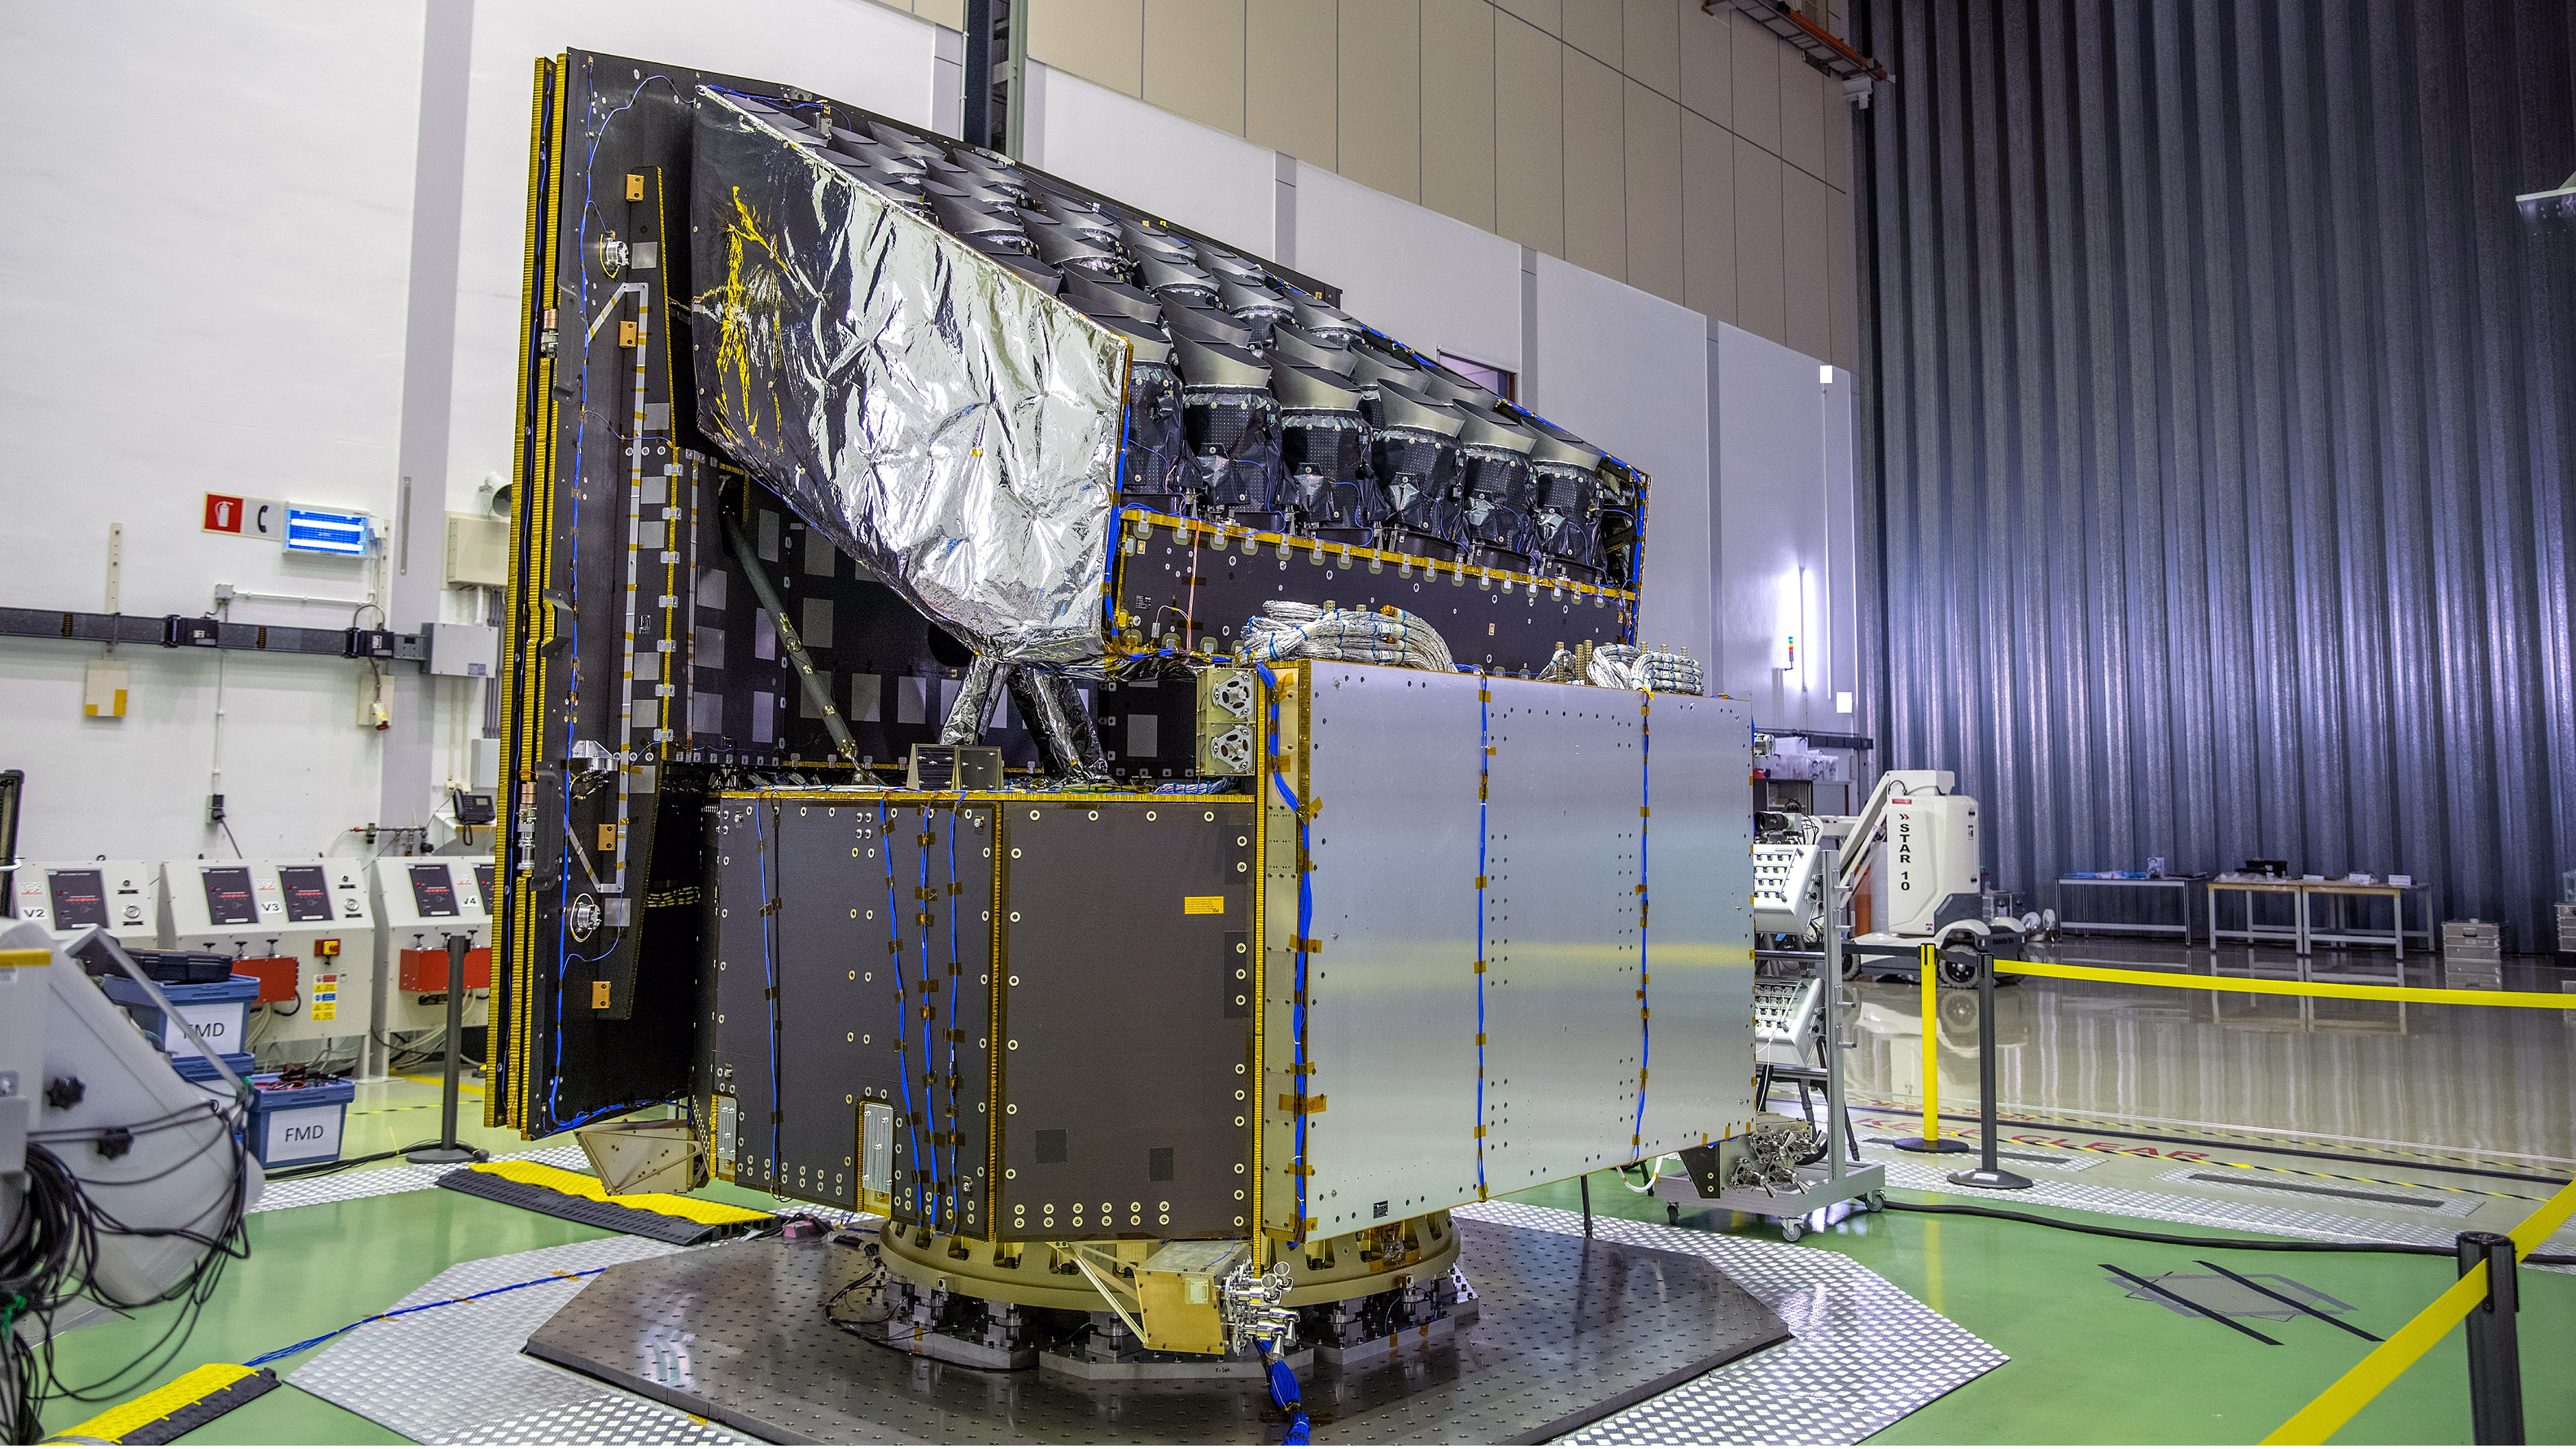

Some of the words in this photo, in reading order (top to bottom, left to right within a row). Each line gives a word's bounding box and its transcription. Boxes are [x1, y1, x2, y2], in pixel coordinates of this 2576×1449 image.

[1899, 823, 1911, 863] STAR
[1901, 871, 1910, 891] 10
[24, 909, 45, 918] V2
[261, 903, 280, 911] V3
[183, 1022, 225, 1039] MD
[285, 1125, 324, 1143] FMD
[2011, 1135, 2210, 1160] CLEAR
